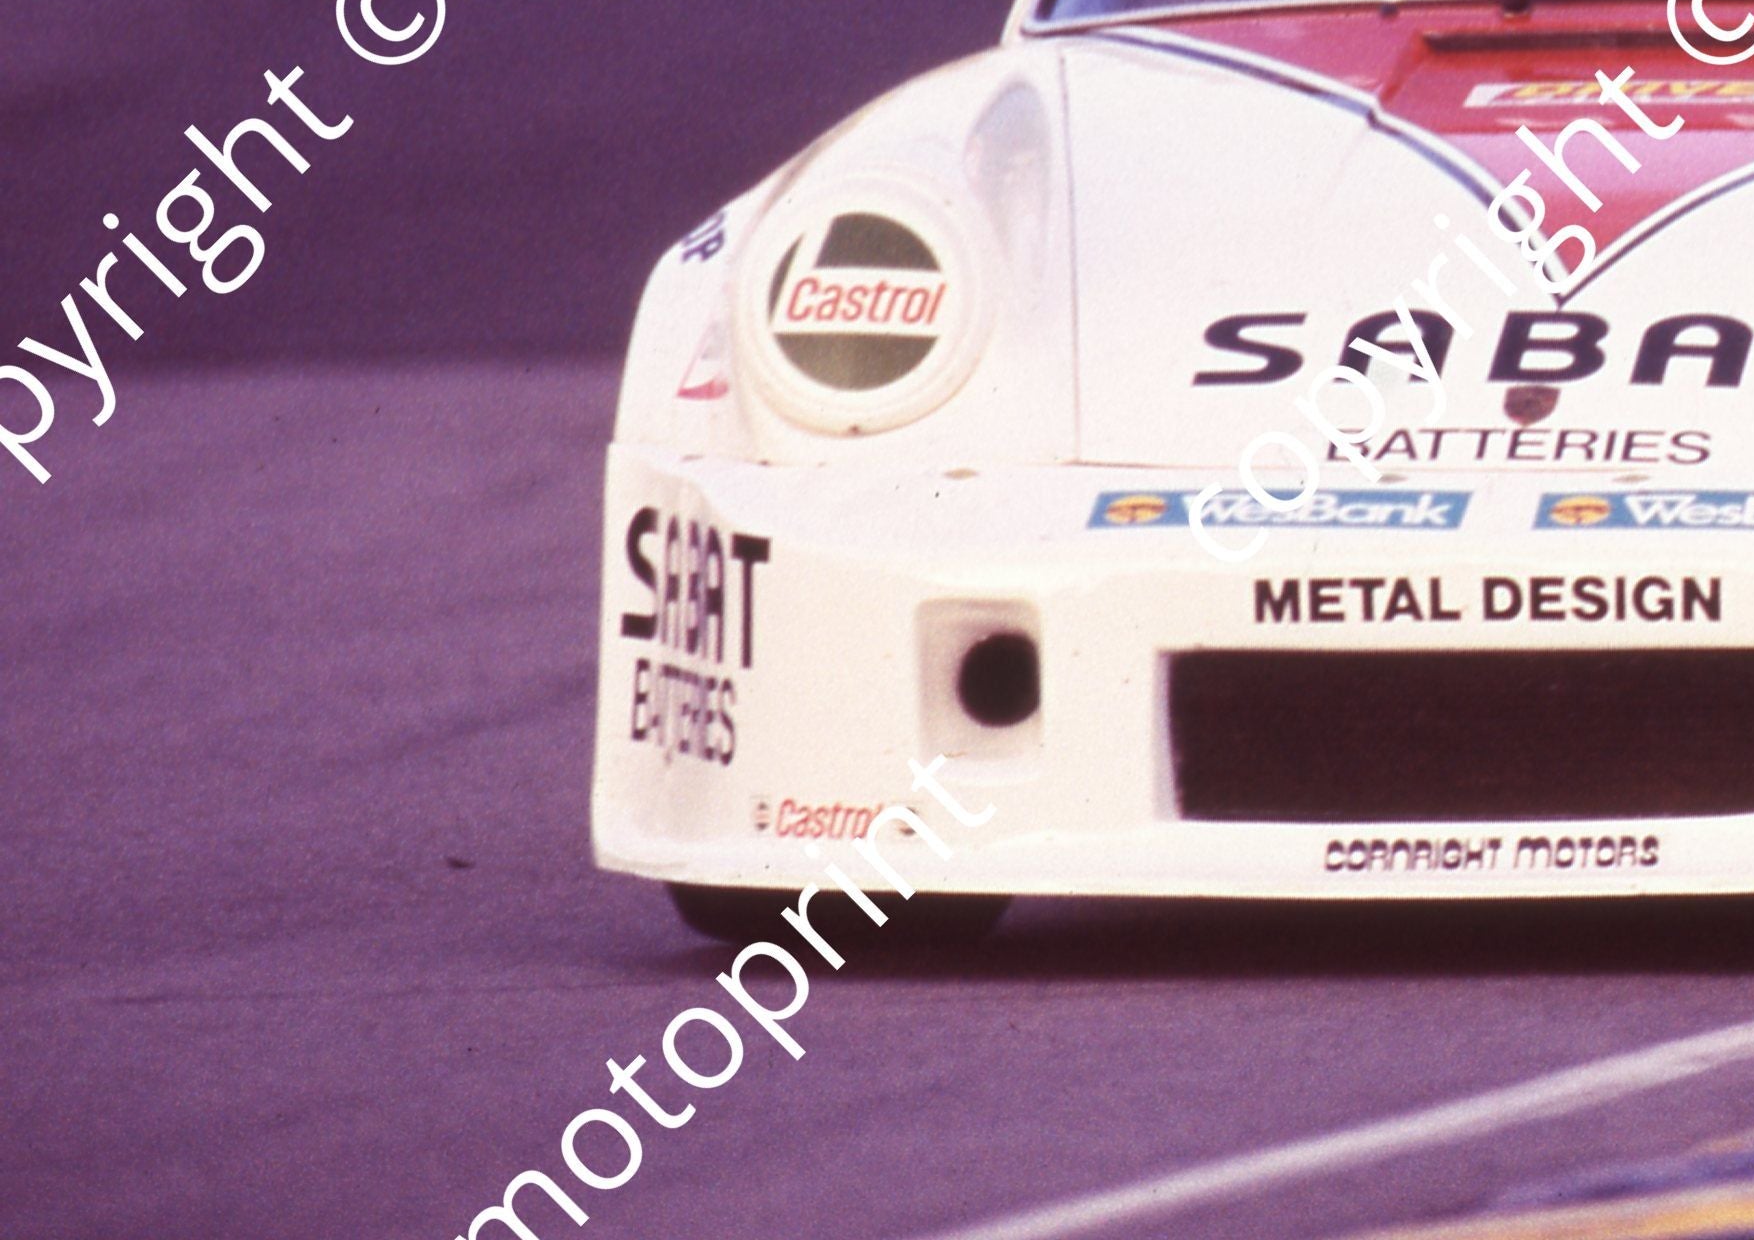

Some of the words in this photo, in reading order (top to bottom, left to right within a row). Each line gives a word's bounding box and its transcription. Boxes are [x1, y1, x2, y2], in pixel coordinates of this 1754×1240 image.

[785, 276, 947, 326] Castrol
[1326, 426, 1713, 466] BATTERIES
[1253, 577, 1461, 624] METAL
[1482, 574, 1724, 624] DESIGN
[775, 796, 885, 840] Castro
[1512, 834, 1660, 869] MOTORS
